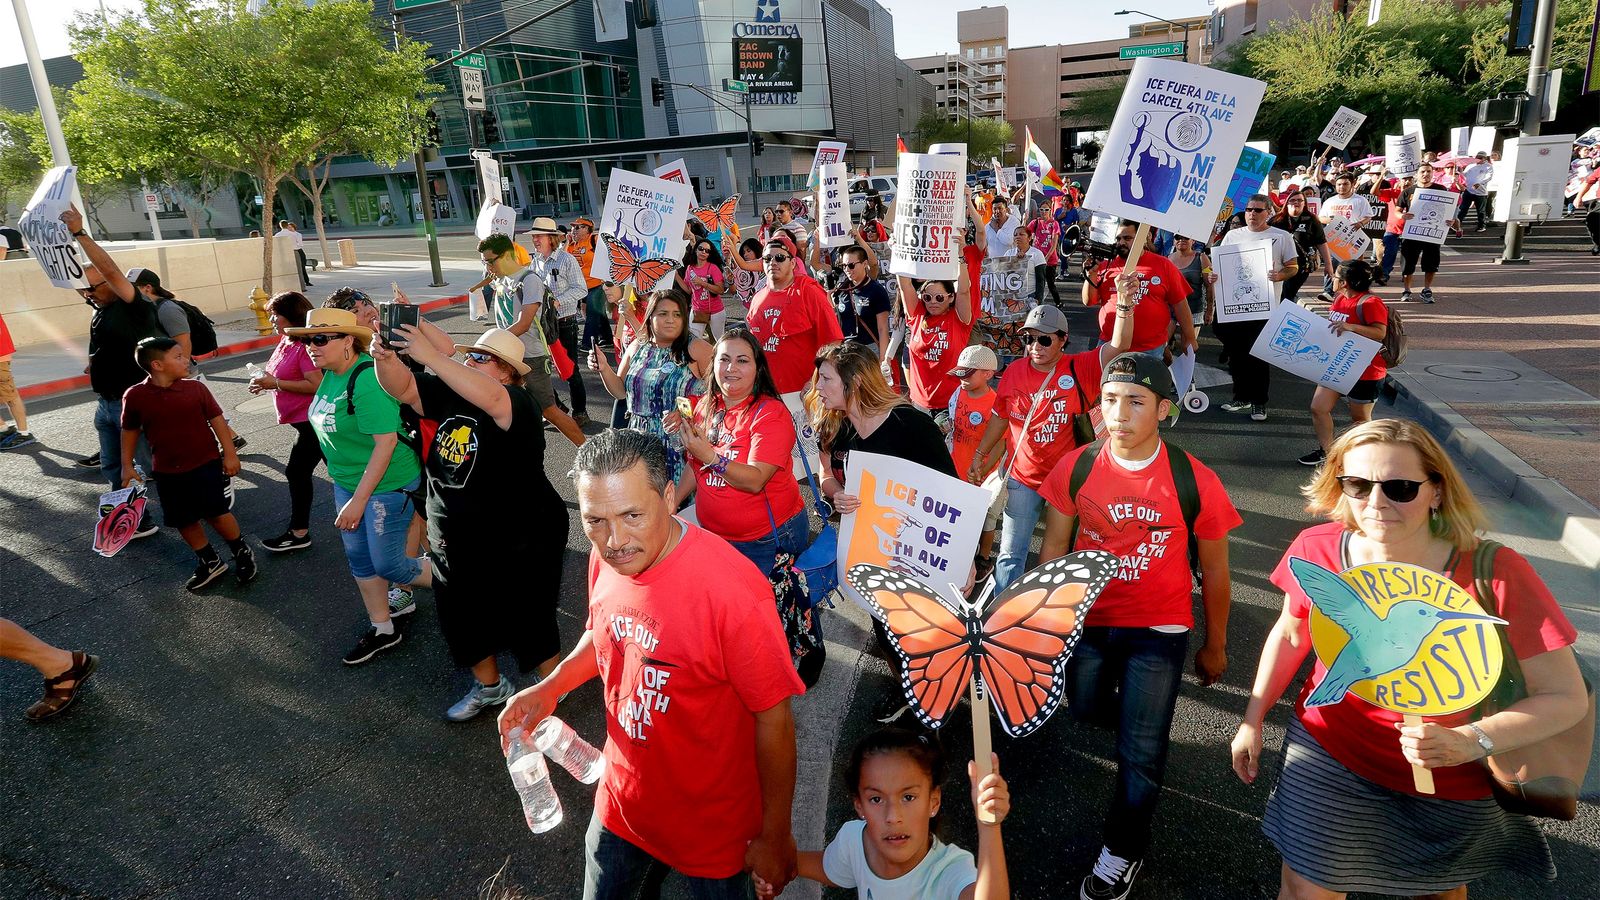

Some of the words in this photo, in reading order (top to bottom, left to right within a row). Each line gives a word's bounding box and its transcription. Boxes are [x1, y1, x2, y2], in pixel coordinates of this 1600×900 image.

[739, 42, 758, 51] ZAC
[1125, 47, 1170, 56] Washington
[469, 56, 484, 67] AVE
[740, 52, 773, 60] BROWN
[740, 61, 765, 69] BAND
[463, 71, 480, 82] ONE
[464, 83, 481, 93] WAY
[1146, 78, 1165, 90] ICE
[1166, 81, 1201, 99] FUERA
[1204, 90, 1218, 103] DE
[1221, 94, 1236, 108] LA
[1142, 92, 1183, 110] CARCEL
[1186, 102, 1207, 116] 4TH
[1210, 108, 1233, 123] AVE
[1190, 153, 1216, 179] Ni
[1236, 150, 1272, 178] ERA
[911, 169, 956, 180] OLONIZE
[823, 177, 838, 187] OUT
[915, 179, 929, 190] NO
[932, 180, 956, 190] BAN
[1182, 176, 1208, 194] UNA
[618, 184, 629, 194] ICE
[631, 187, 653, 199] FUERA
[655, 192, 664, 201] DE
[665, 193, 675, 204] LA
[827, 189, 838, 199] OF
[914, 190, 927, 199] NO
[930, 190, 955, 200] WALL
[1178, 189, 1206, 207] MAS
[617, 195, 642, 207] CARCEL
[645, 201, 658, 210] 4TH
[660, 204, 673, 214] AVE
[923, 205, 944, 213] STAND
[946, 205, 954, 213] UP
[824, 223, 845, 238] AIL
[652, 236, 667, 255] Ni
[895, 247, 950, 256] LIDARITY
[31, 243, 83, 281] IGHTS
[911, 255, 950, 264] WICONI
[1329, 311, 1349, 322] IGHT
[768, 336, 779, 345] AVE
[938, 332, 947, 341] OF
[934, 340, 949, 349] 4TH
[929, 348, 942, 356] AVE
[1053, 400, 1066, 412] OF
[1048, 413, 1068, 424] 4TH
[1041, 424, 1059, 433] AVE
[724, 450, 739, 461] OF
[885, 479, 918, 507] ICE
[922, 496, 962, 524] OUT
[1136, 506, 1162, 522] OUT
[924, 526, 951, 548] OF
[1151, 531, 1172, 543] OF
[882, 539, 913, 558] 4TH
[918, 549, 949, 572] AVE
[1137, 543, 1167, 558] 4TH
[1121, 556, 1150, 570] AVE
[635, 624, 660, 653] OUT
[1375, 623, 1490, 709] RESIST!
[644, 666, 671, 690] OF
[636, 683, 670, 713] 4TH
[625, 697, 653, 727] AVE
